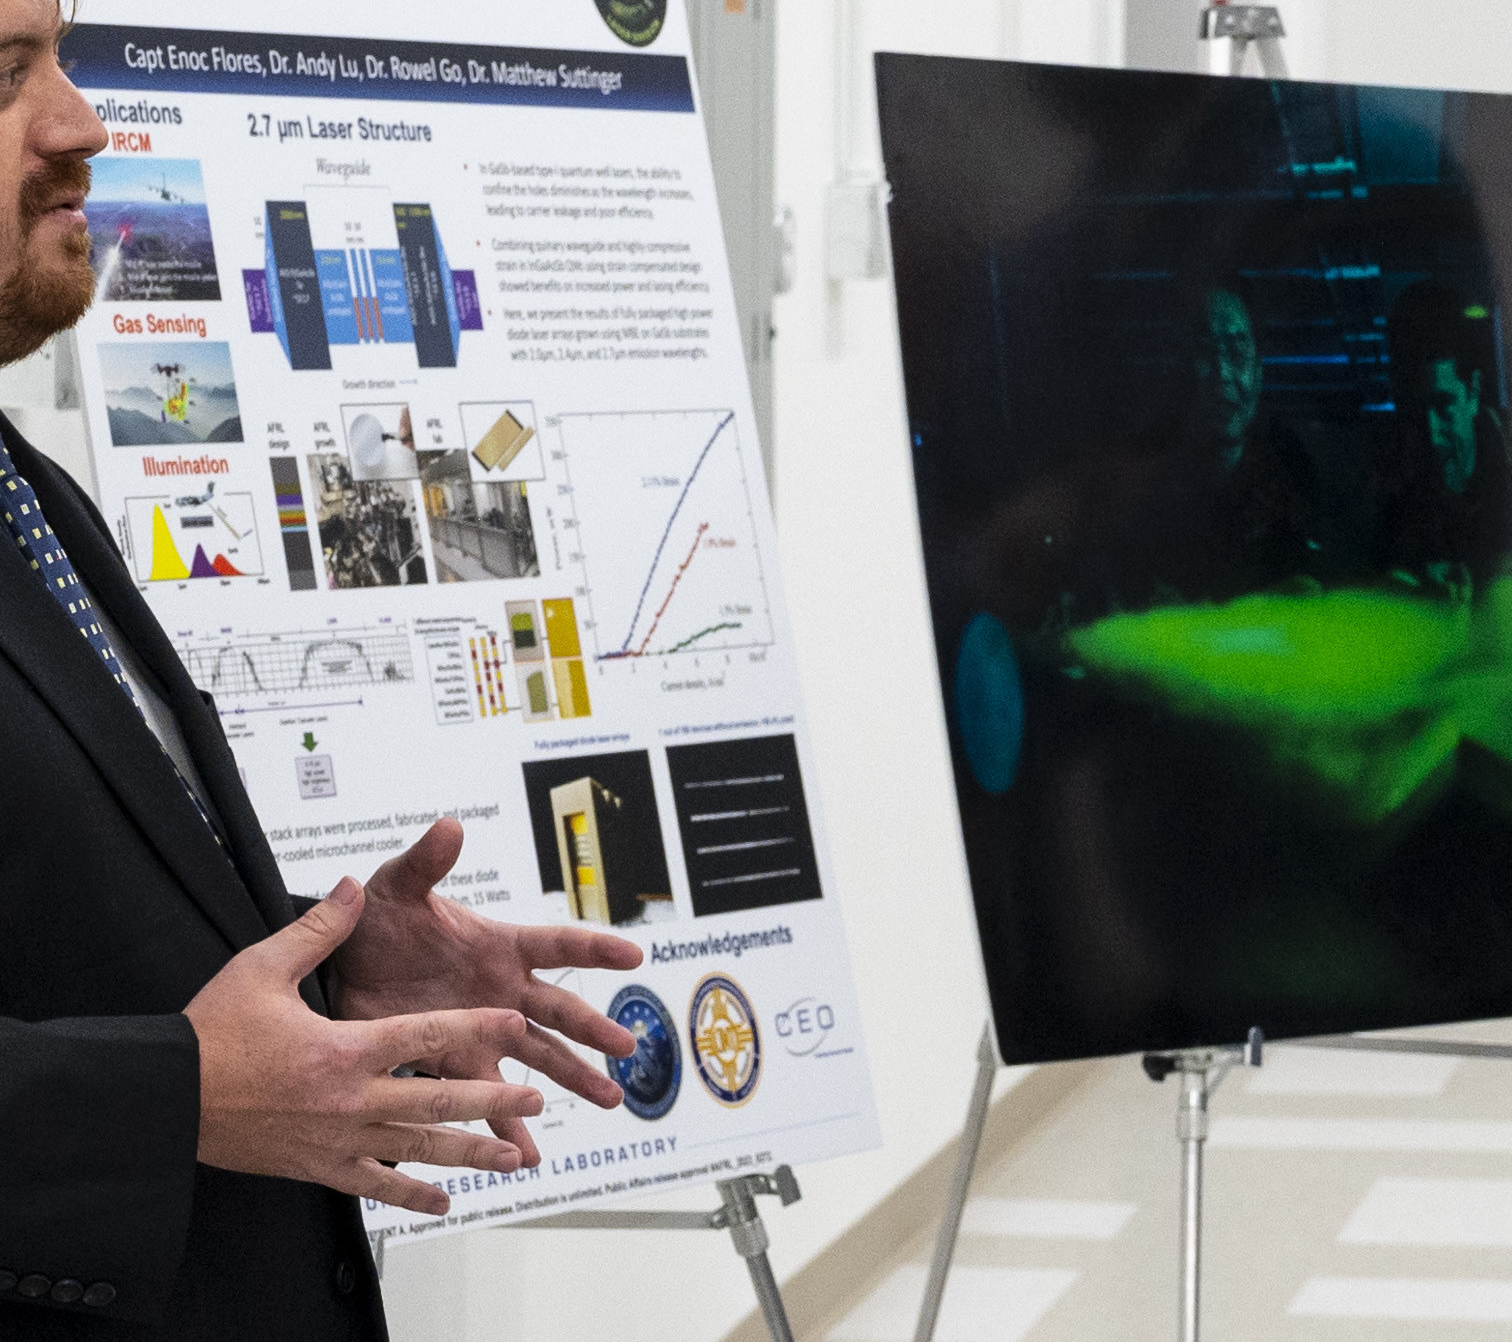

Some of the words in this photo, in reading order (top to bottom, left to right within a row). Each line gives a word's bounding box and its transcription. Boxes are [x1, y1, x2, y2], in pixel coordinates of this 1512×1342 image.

[125, 42, 165, 74] Capt
[167, 44, 208, 72] Enoc
[211, 46, 267, 78] Flores,
[269, 49, 293, 75] Dr.
[296, 51, 337, 83] Andy
[339, 53, 364, 82] Lu,
[365, 54, 389, 79] Dr.
[390, 56, 438, 81] Rowel
[439, 58, 467, 87] Go,
[467, 59, 489, 84] Dr.
[491, 60, 558, 87] Matthew
[92, 98, 183, 126] plications
[111, 131, 153, 152] IRCM
[247, 113, 272, 138] 2.7
[307, 115, 353, 140] Laser
[357, 116, 432, 142] Structure
[316, 157, 371, 180] Waveguide
[113, 312, 143, 336] Gas
[146, 312, 207, 339] Sensing
[142, 454, 229, 477] Illumination
[270, 827, 293, 842] stack
[295, 825, 323, 842] arrays
[324, 824, 346, 837] were
[461, 804, 501, 822] packaged
[316, 839, 376, 859] microchannel
[650, 924, 794, 965] Acknowledgements
[775, 1003, 837, 1038] CEO
[551, 1135, 678, 1176] LABORATORY
[409, 1216, 446, 1234] Approved
[446, 1215, 459, 1226] for
[460, 1210, 483, 1225] public
[515, 1194, 559, 1213] Distribution
